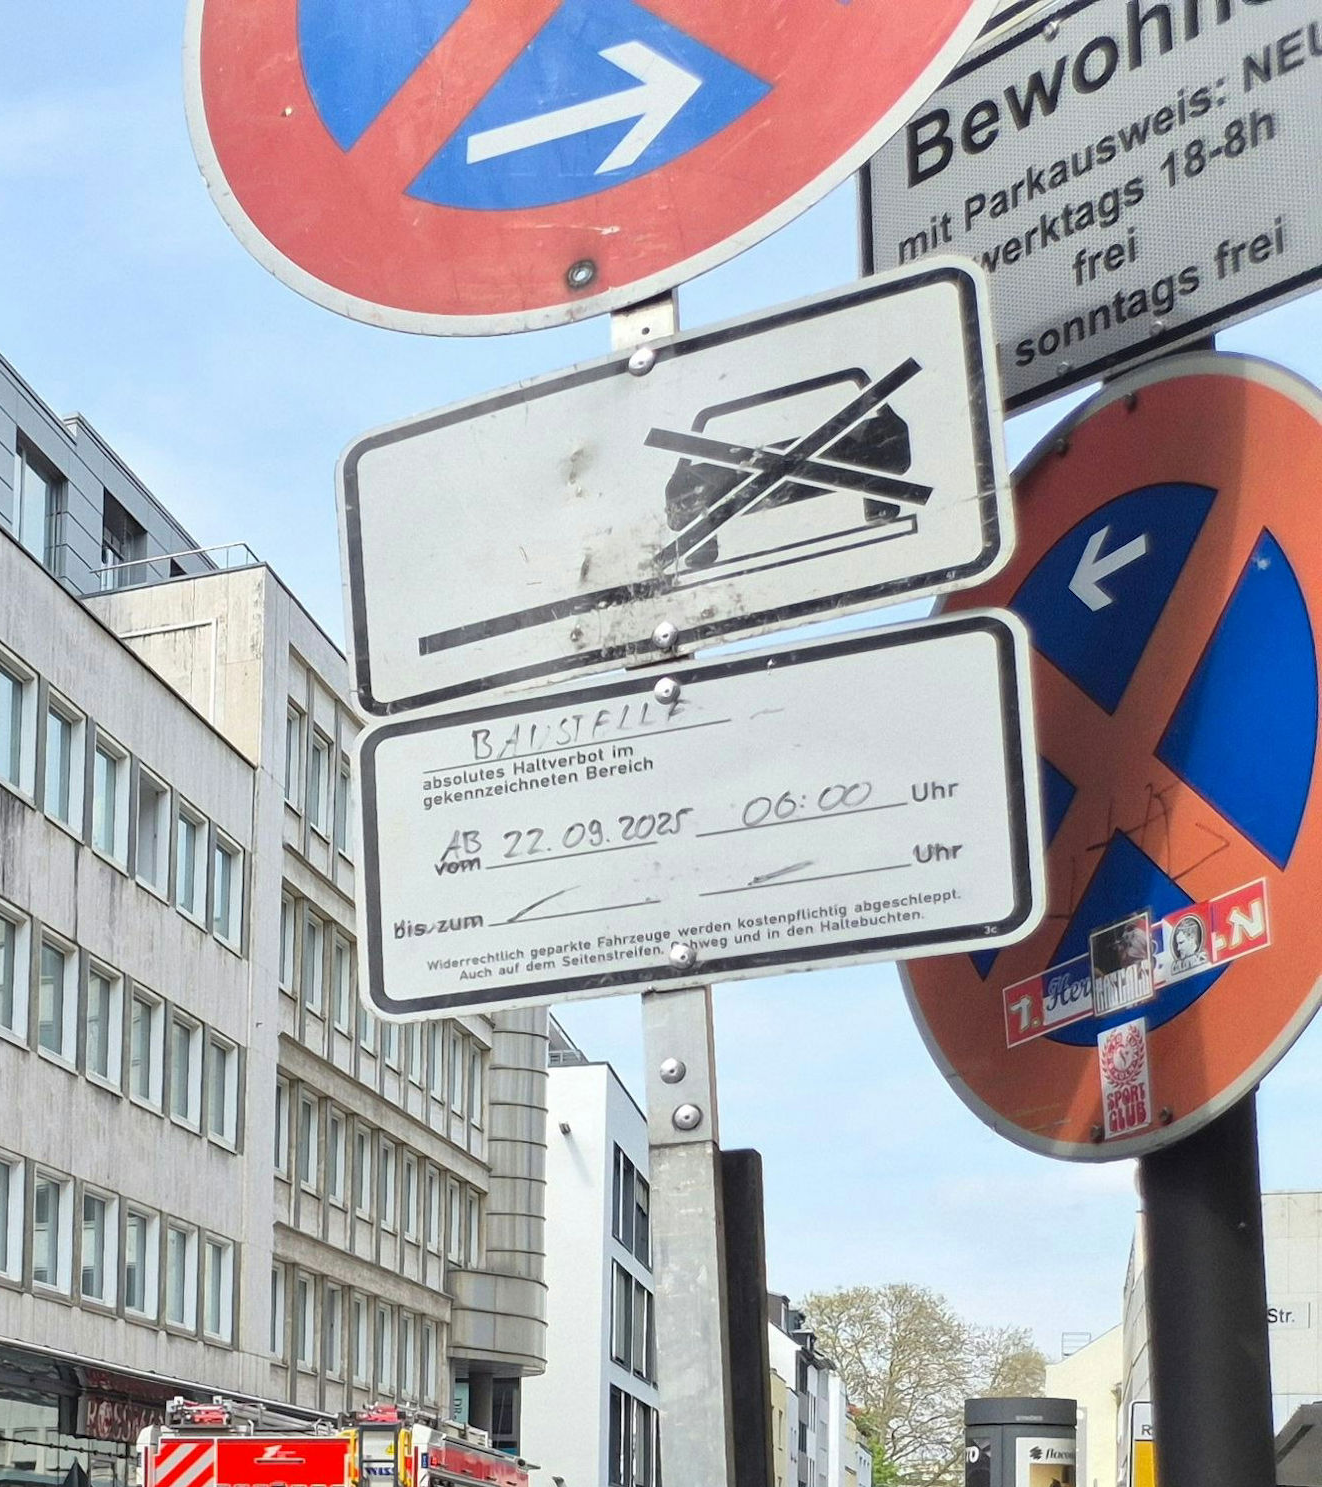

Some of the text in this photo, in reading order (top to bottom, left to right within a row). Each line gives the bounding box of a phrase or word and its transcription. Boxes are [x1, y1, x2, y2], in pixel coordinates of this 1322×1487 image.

[906, 0, 1271, 188] Bewohn
[898, 212, 952, 265] mit
[964, 76, 1229, 232] Parkausweis:
[974, 109, 1277, 274] werktags 18-8h
[1015, 216, 1287, 367] sonntags frei
[1073, 227, 1139, 287] frei
[423, 744, 634, 791] absolutes Haltverbot im
[423, 757, 654, 810] gekennzeichneten Bereich
[741, 782, 872, 829] 06:00
[434, 781, 960, 876] vom Uhr
[436, 914, 484, 934] zum
[912, 842, 963, 863] Uhr
[427, 888, 962, 971] Widerrechtlich geparkte Fahrzeuge werden kostenpflichtig abgeschleppt.
[459, 967, 492, 981] Auch
[498, 964, 520, 977] auf
[526, 959, 555, 973] dem
[734, 931, 753, 945] und
[767, 928, 780, 940] in
[787, 924, 814, 938] den
[820, 910, 925, 933] Haltebuchten.
[1107, 1086, 1145, 1110] SPORT
[1109, 1102, 1147, 1131] CLUB
